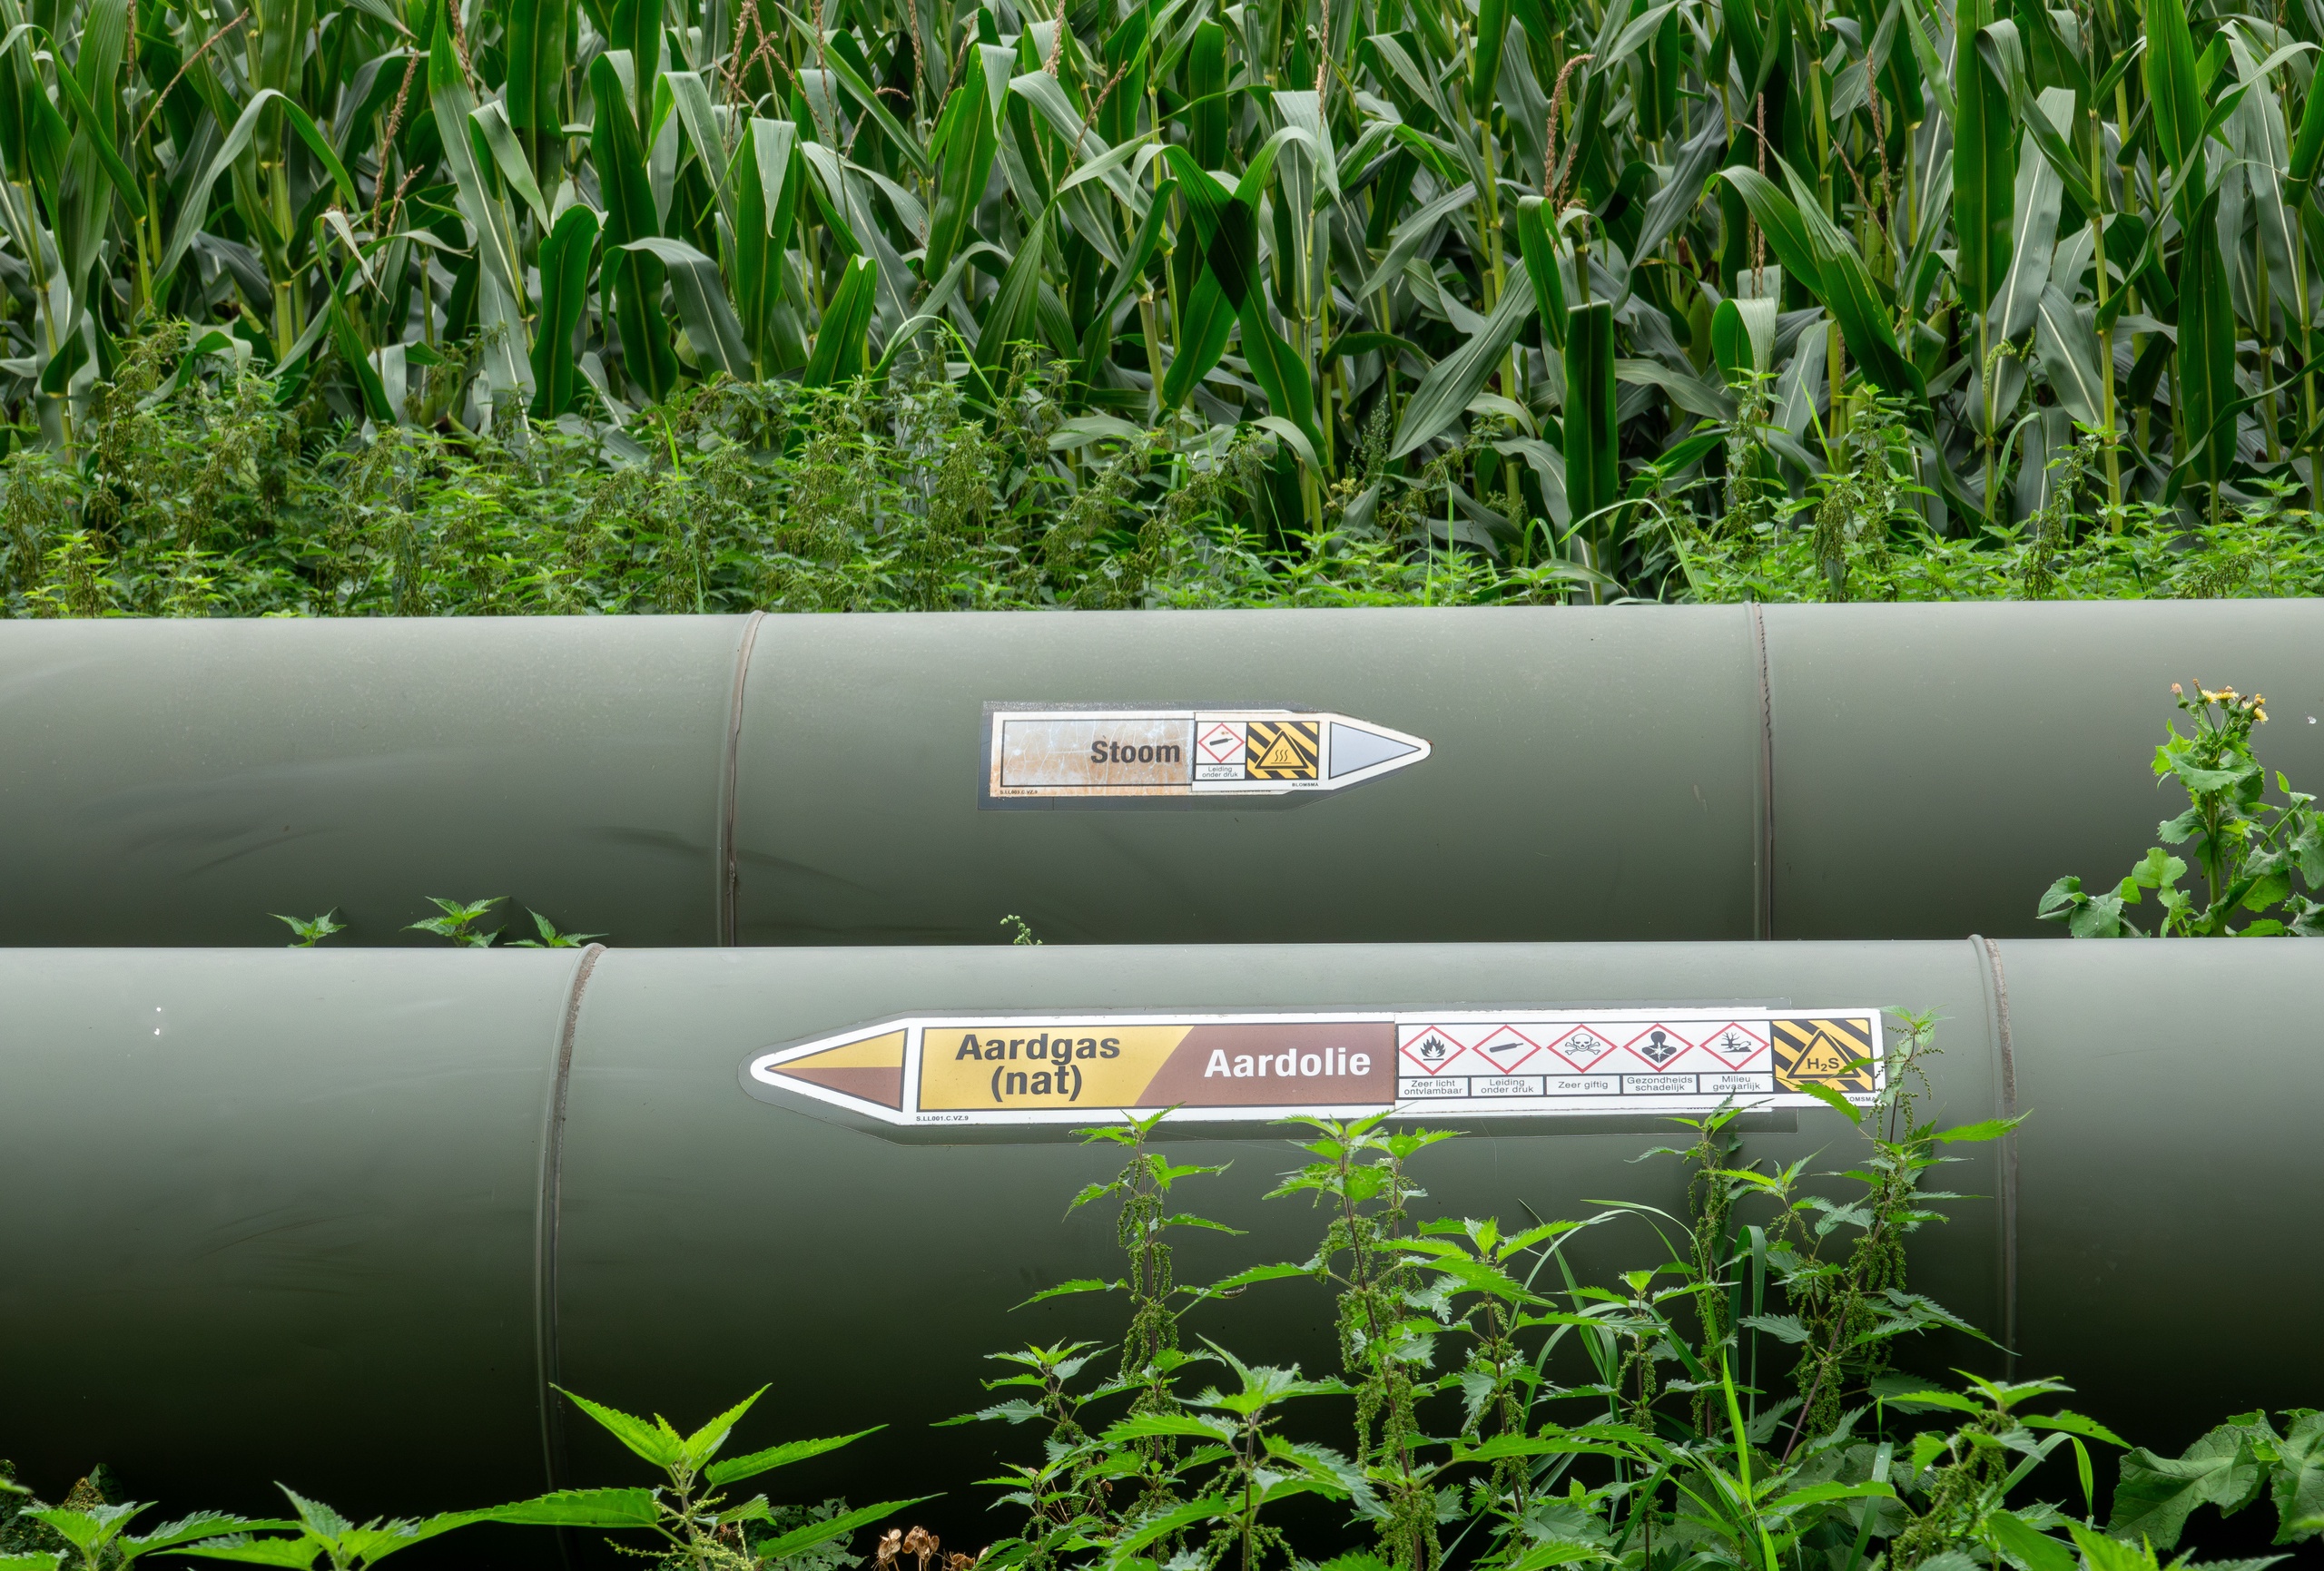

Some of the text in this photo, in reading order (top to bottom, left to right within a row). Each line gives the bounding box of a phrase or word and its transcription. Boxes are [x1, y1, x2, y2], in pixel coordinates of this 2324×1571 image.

[1090, 739, 1181, 764] Stoom
[1207, 766, 1233, 776] Leiding
[955, 1034, 1121, 1065] Aardgas
[1204, 1048, 1372, 1078] Aardolie
[990, 1065, 1083, 1102] (nat)
[1411, 1079, 1456, 1088] Zeer licht
[1489, 1078, 1525, 1088] Leiding
[1558, 1080, 1609, 1090] Zeer giftig
[1627, 1075, 1693, 1085] Gezondheids
[1403, 1087, 1463, 1095] ontvlambaar
[1481, 1085, 1534, 1094] onder druk
[1635, 1084, 1685, 1093] schadelijk
[1712, 1082, 1761, 1092] gevaarlijk
